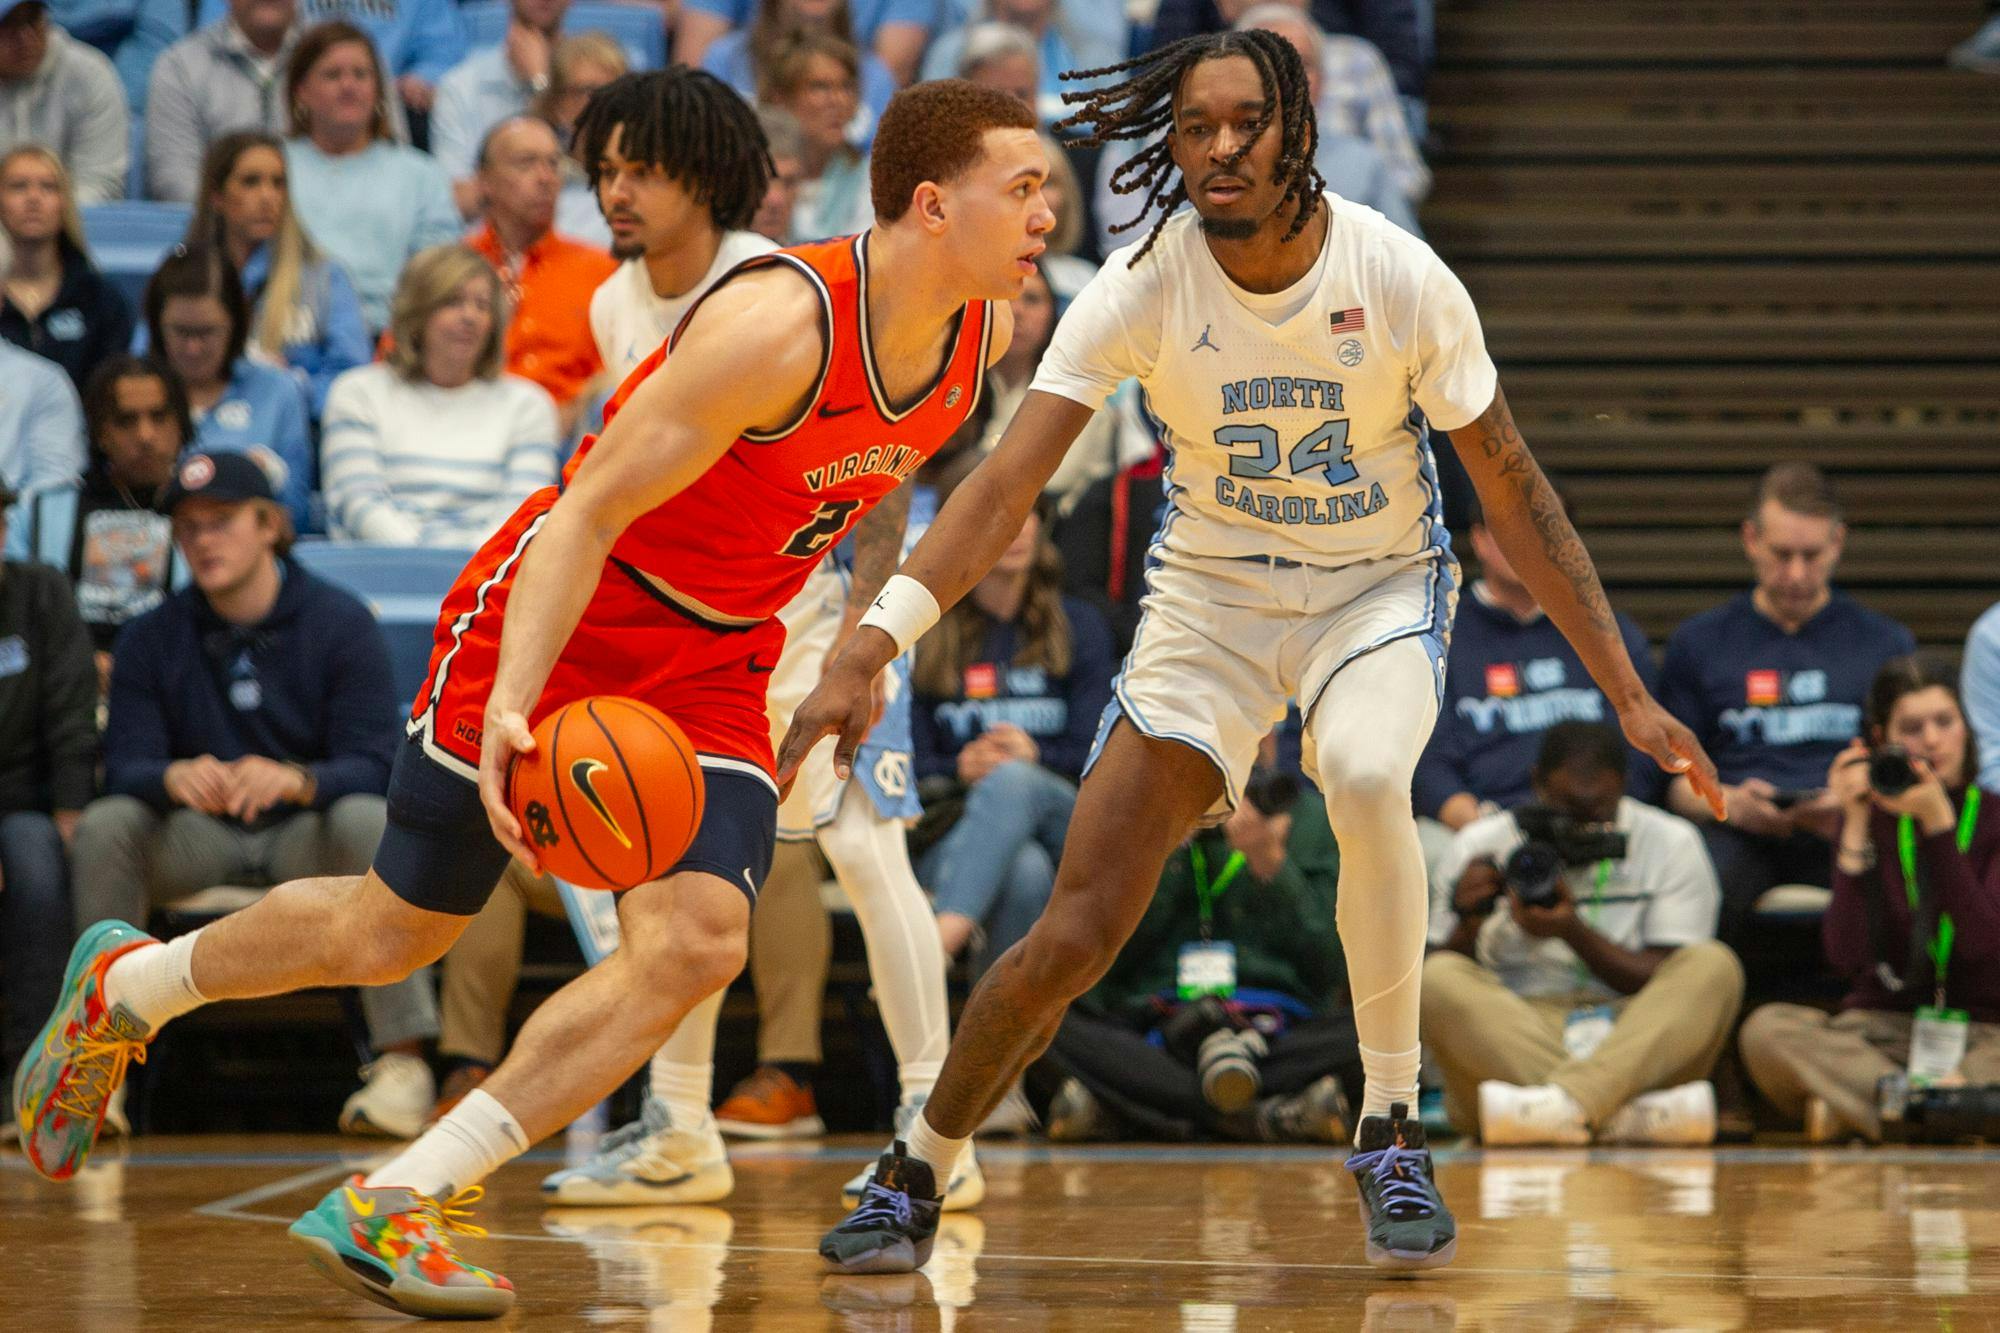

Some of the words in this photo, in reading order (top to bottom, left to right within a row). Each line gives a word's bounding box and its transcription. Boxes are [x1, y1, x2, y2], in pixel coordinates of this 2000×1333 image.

[1221, 376, 1345, 415] NORTH
[1213, 417, 1360, 487] 24
[1215, 475, 1390, 525] CAROLINA
[774, 499, 864, 559] 2
